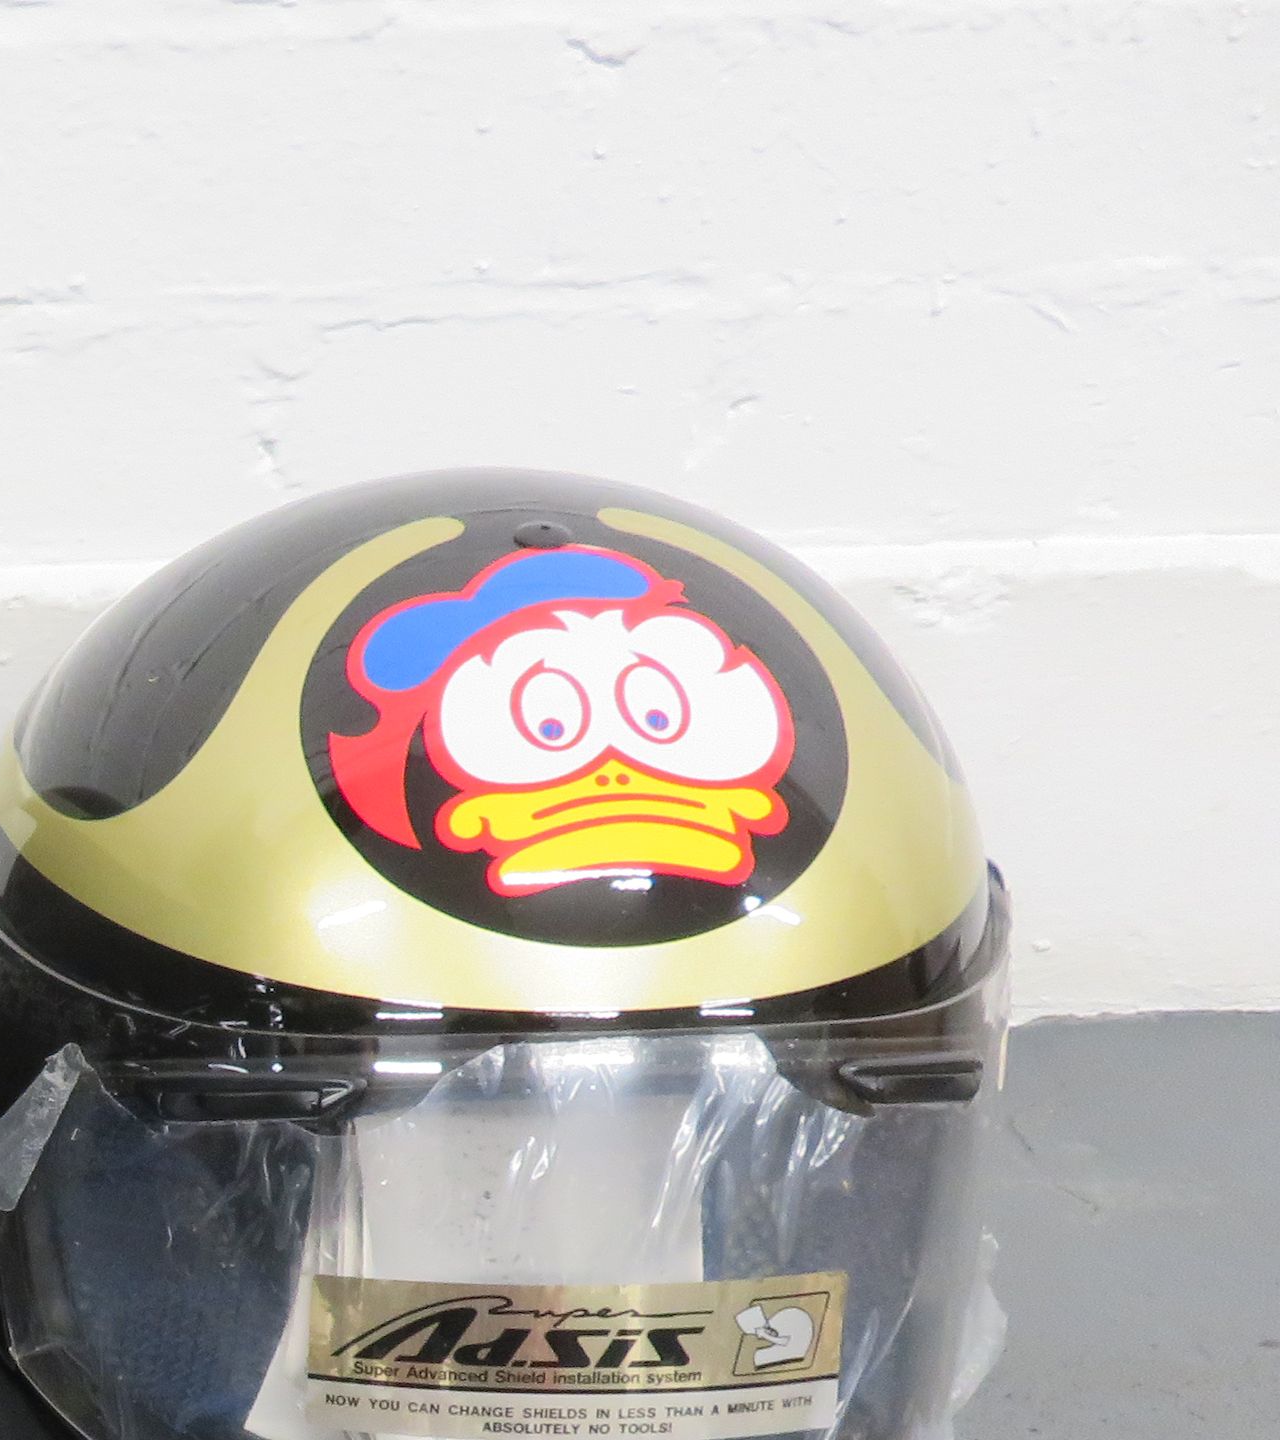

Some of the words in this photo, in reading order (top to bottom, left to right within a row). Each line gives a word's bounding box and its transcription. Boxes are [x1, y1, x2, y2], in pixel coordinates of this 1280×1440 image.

[354, 1361, 400, 1377] Super
[406, 1366, 488, 1383] Advanced
[495, 1371, 546, 1384] Shield
[553, 1371, 640, 1385] installation
[647, 1371, 702, 1385] system
[325, 1394, 360, 1407] NOW
[369, 1399, 400, 1411] YOU
[408, 1402, 440, 1414] CAN
[448, 1405, 514, 1418] CHANGE
[523, 1408, 587, 1419] SHIELDS
[596, 1408, 610, 1419] IN
[618, 1408, 656, 1418] LESS
[665, 1406, 703, 1417] THAN
[711, 1406, 720, 1415] A
[728, 1400, 774, 1414] MINUTE
[782, 1396, 813, 1408] WITH
[483, 1422, 580, 1435] ABSOLUTELY
[589, 1424, 610, 1434] NO
[619, 1423, 672, 1434] TOOLS!
